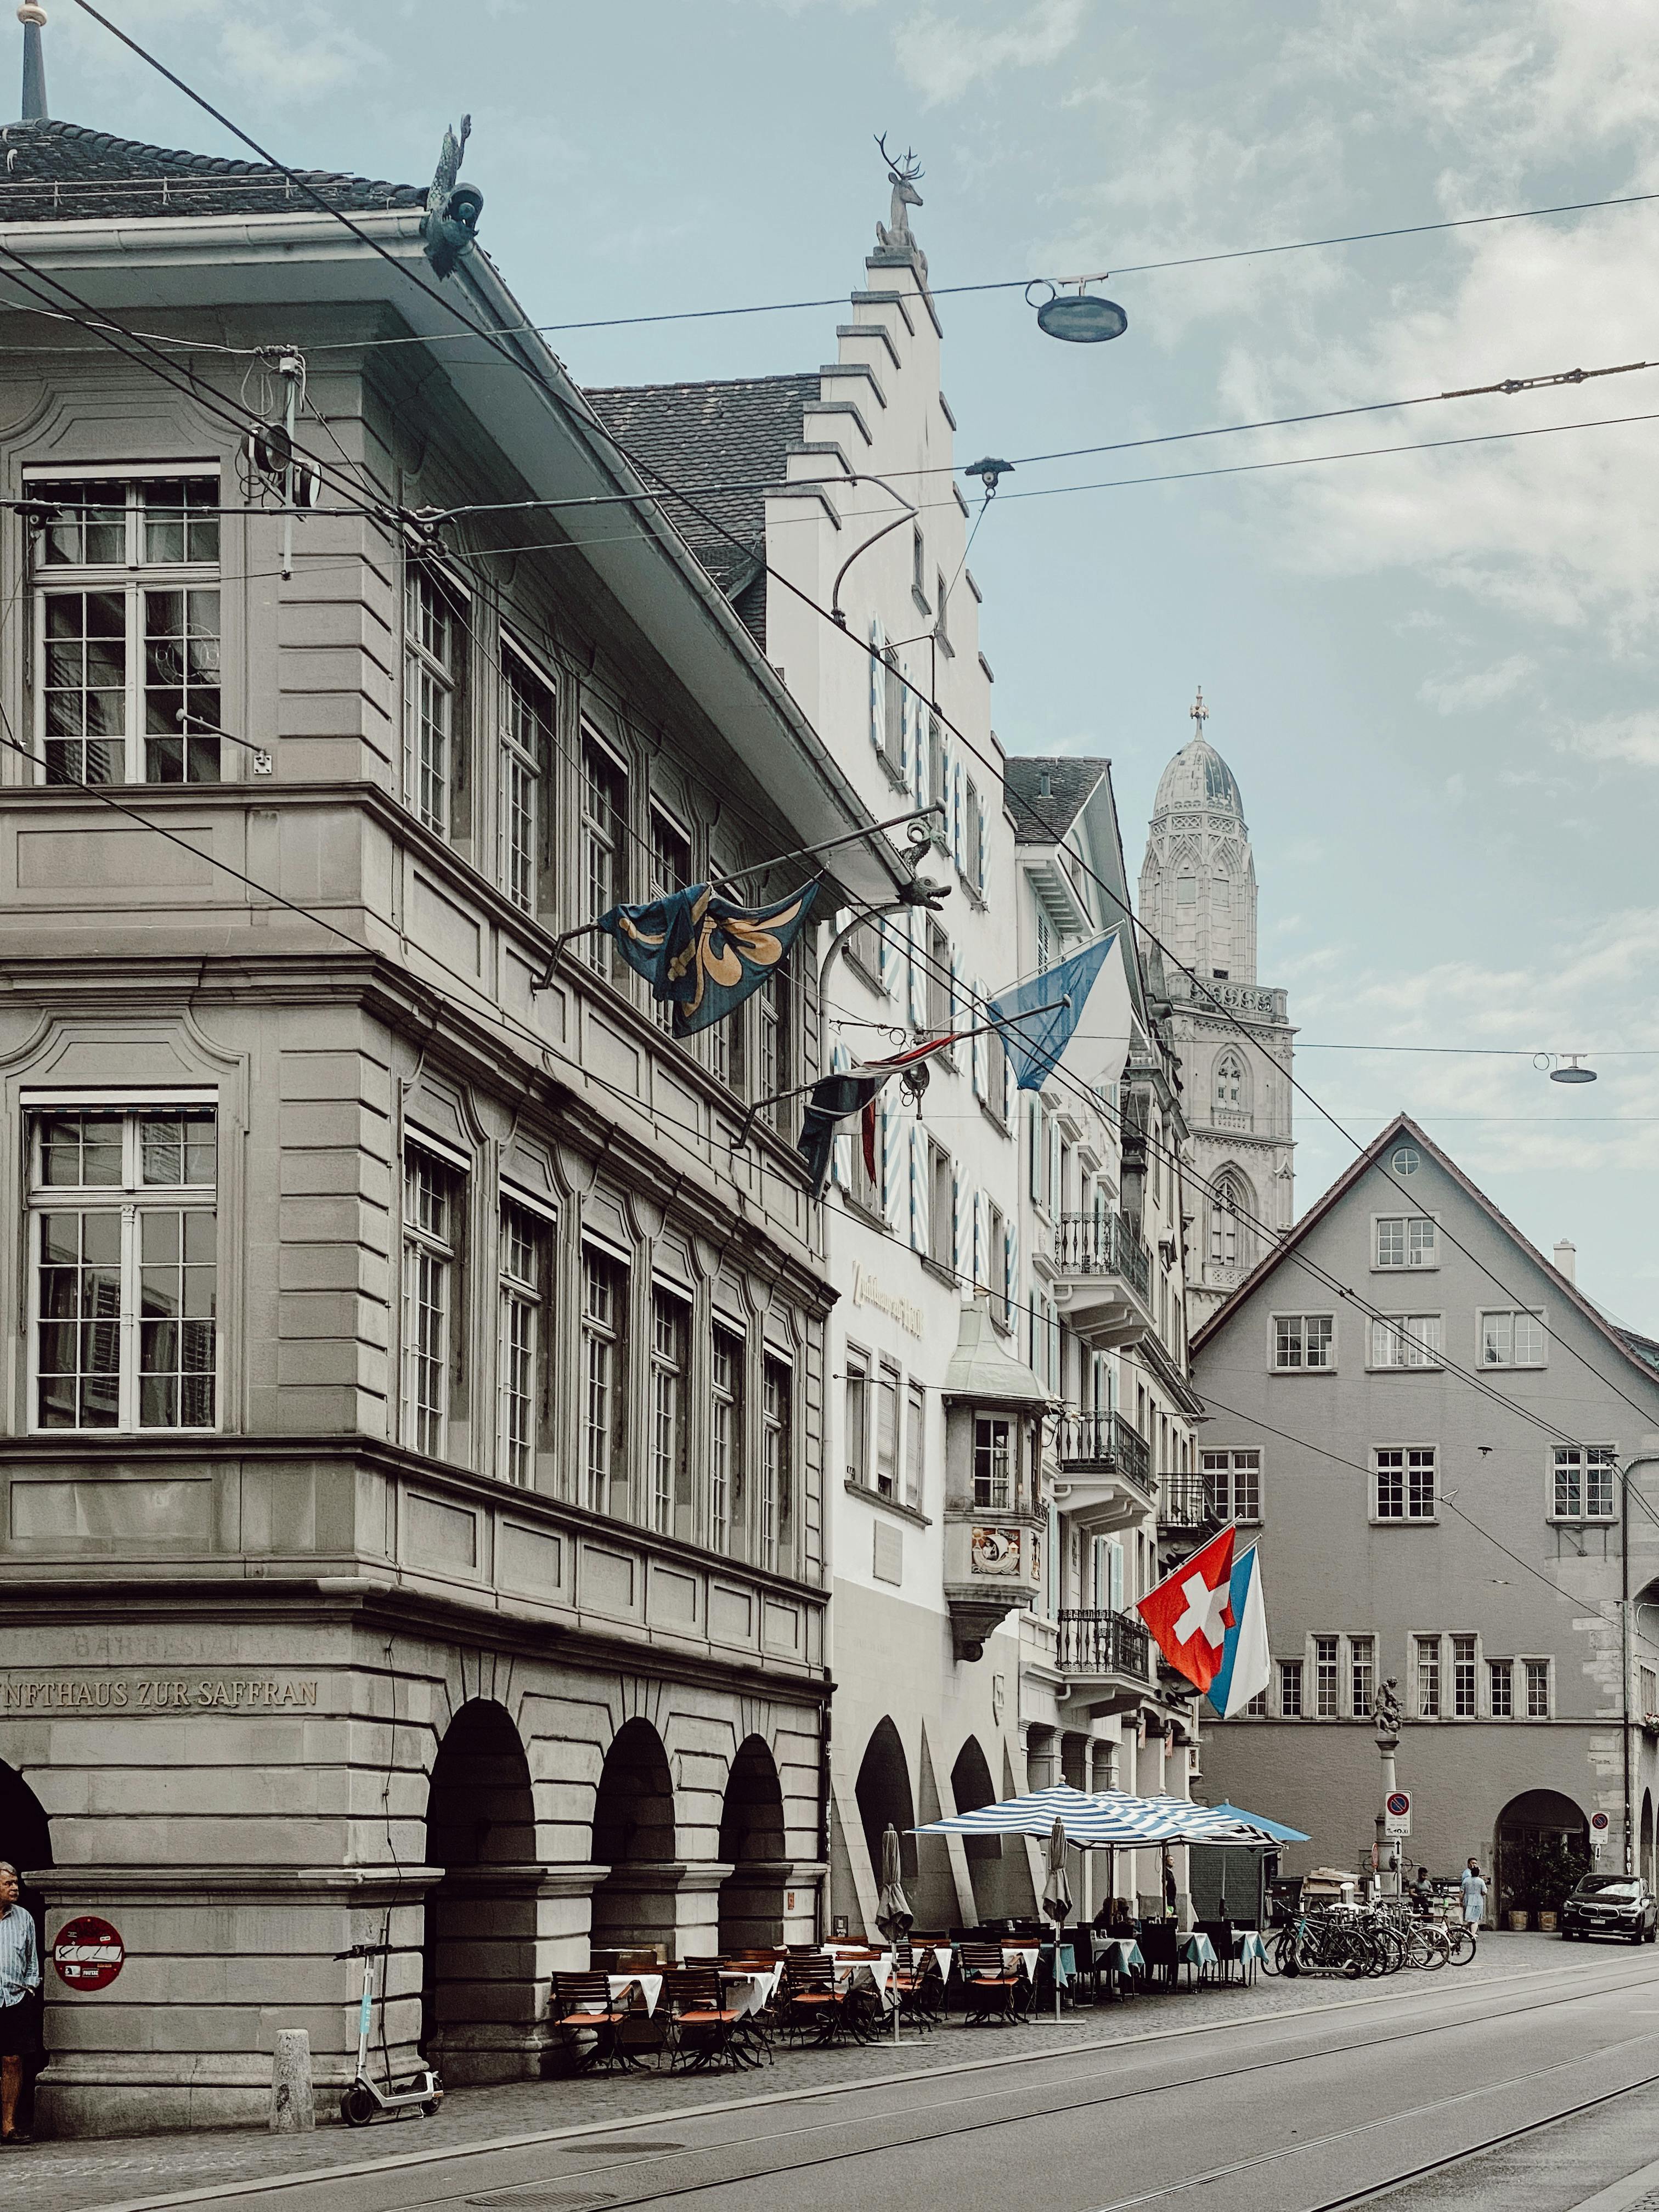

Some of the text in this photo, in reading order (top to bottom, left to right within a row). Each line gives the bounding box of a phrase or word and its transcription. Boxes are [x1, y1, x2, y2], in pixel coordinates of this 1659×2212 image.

[0, 1680, 318, 1707] NFTHAUS ZUR SAFFRAN
